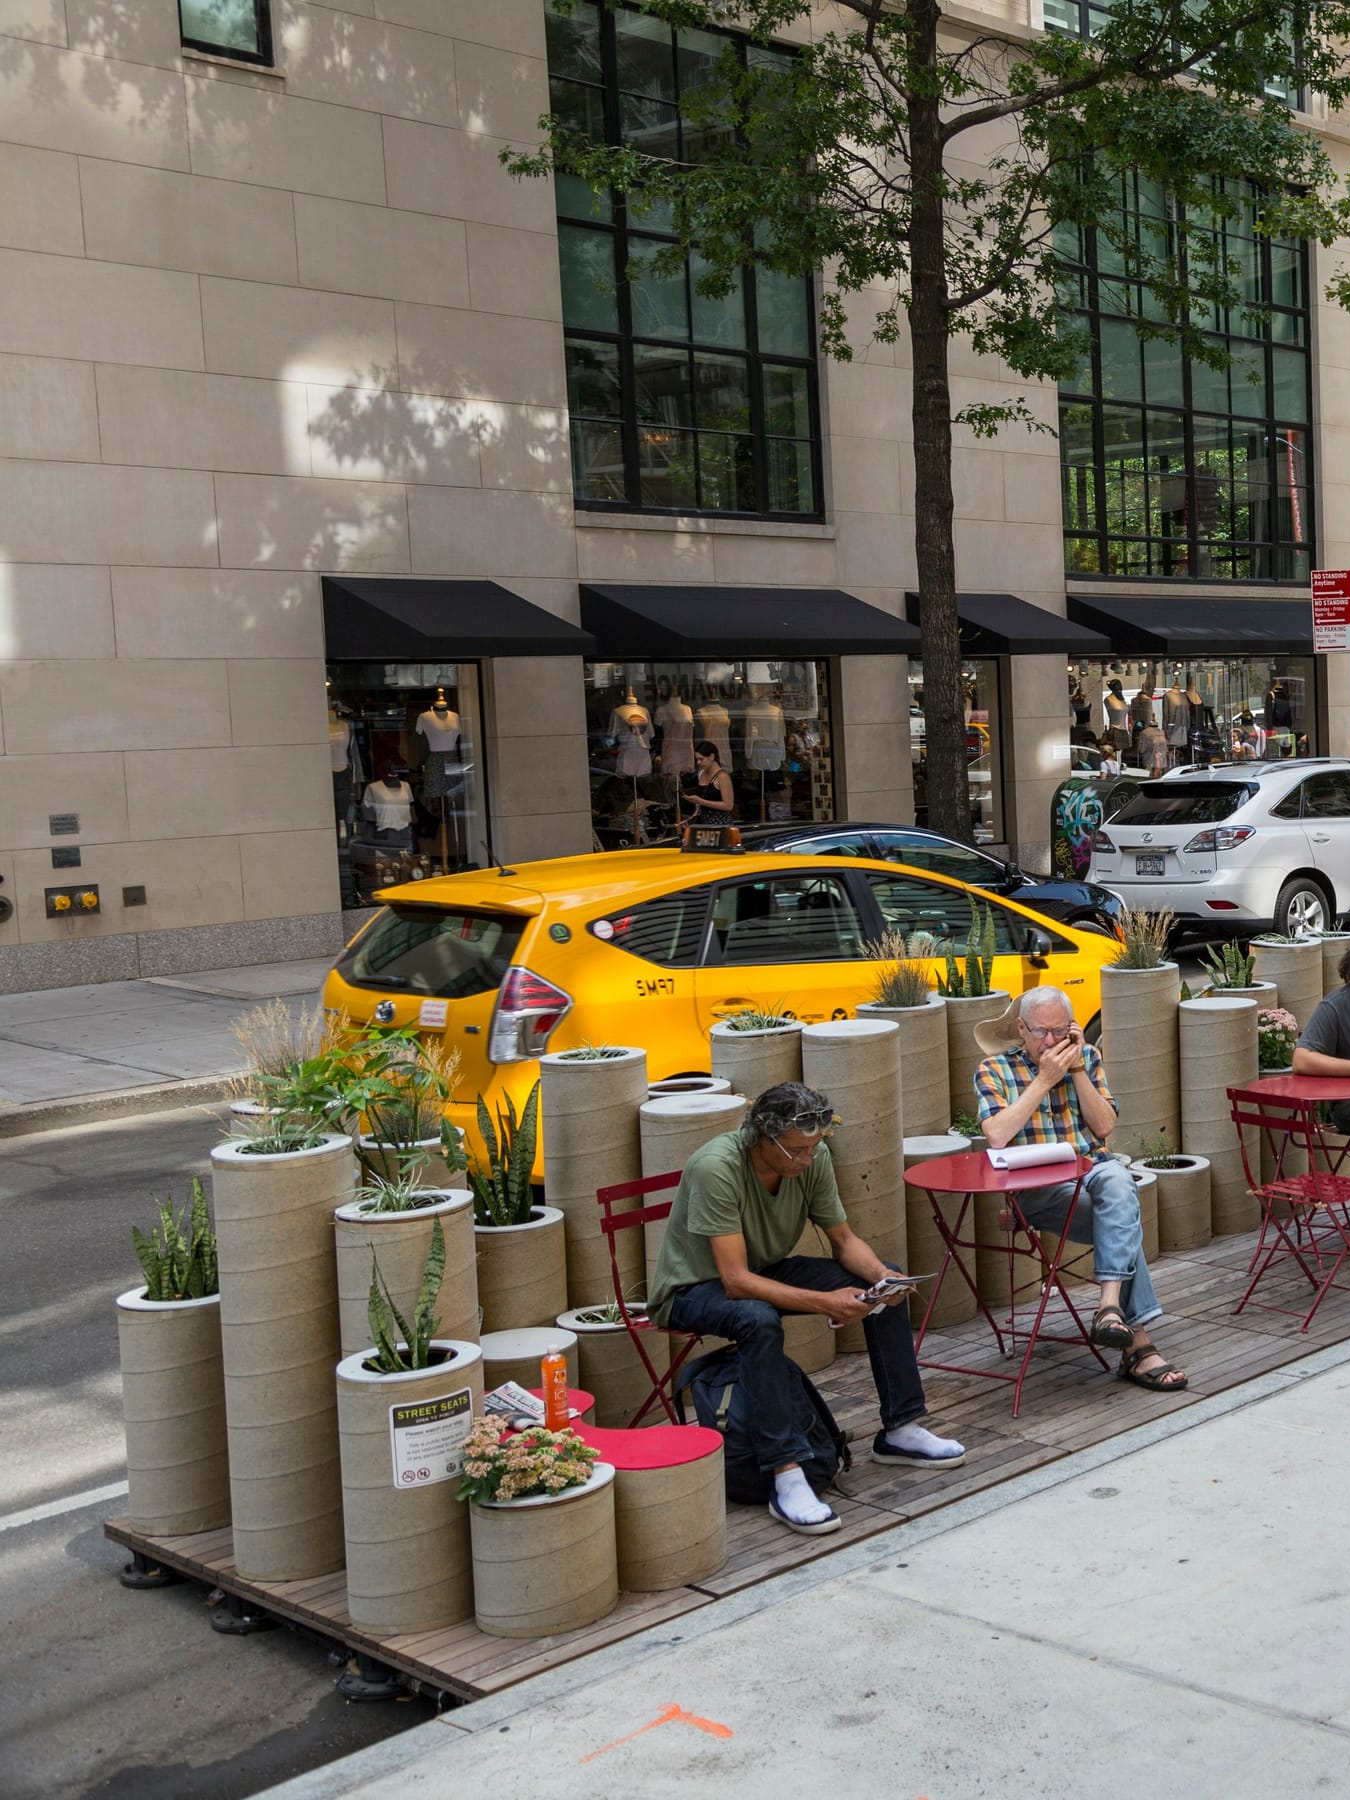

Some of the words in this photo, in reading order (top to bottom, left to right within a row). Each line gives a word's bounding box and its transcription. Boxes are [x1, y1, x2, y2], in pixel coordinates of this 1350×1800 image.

[696, 830, 720, 847] 5M97
[636, 978, 675, 997] 5M97
[397, 1405, 438, 1420] STREET
[440, 1395, 468, 1413] SEATS
